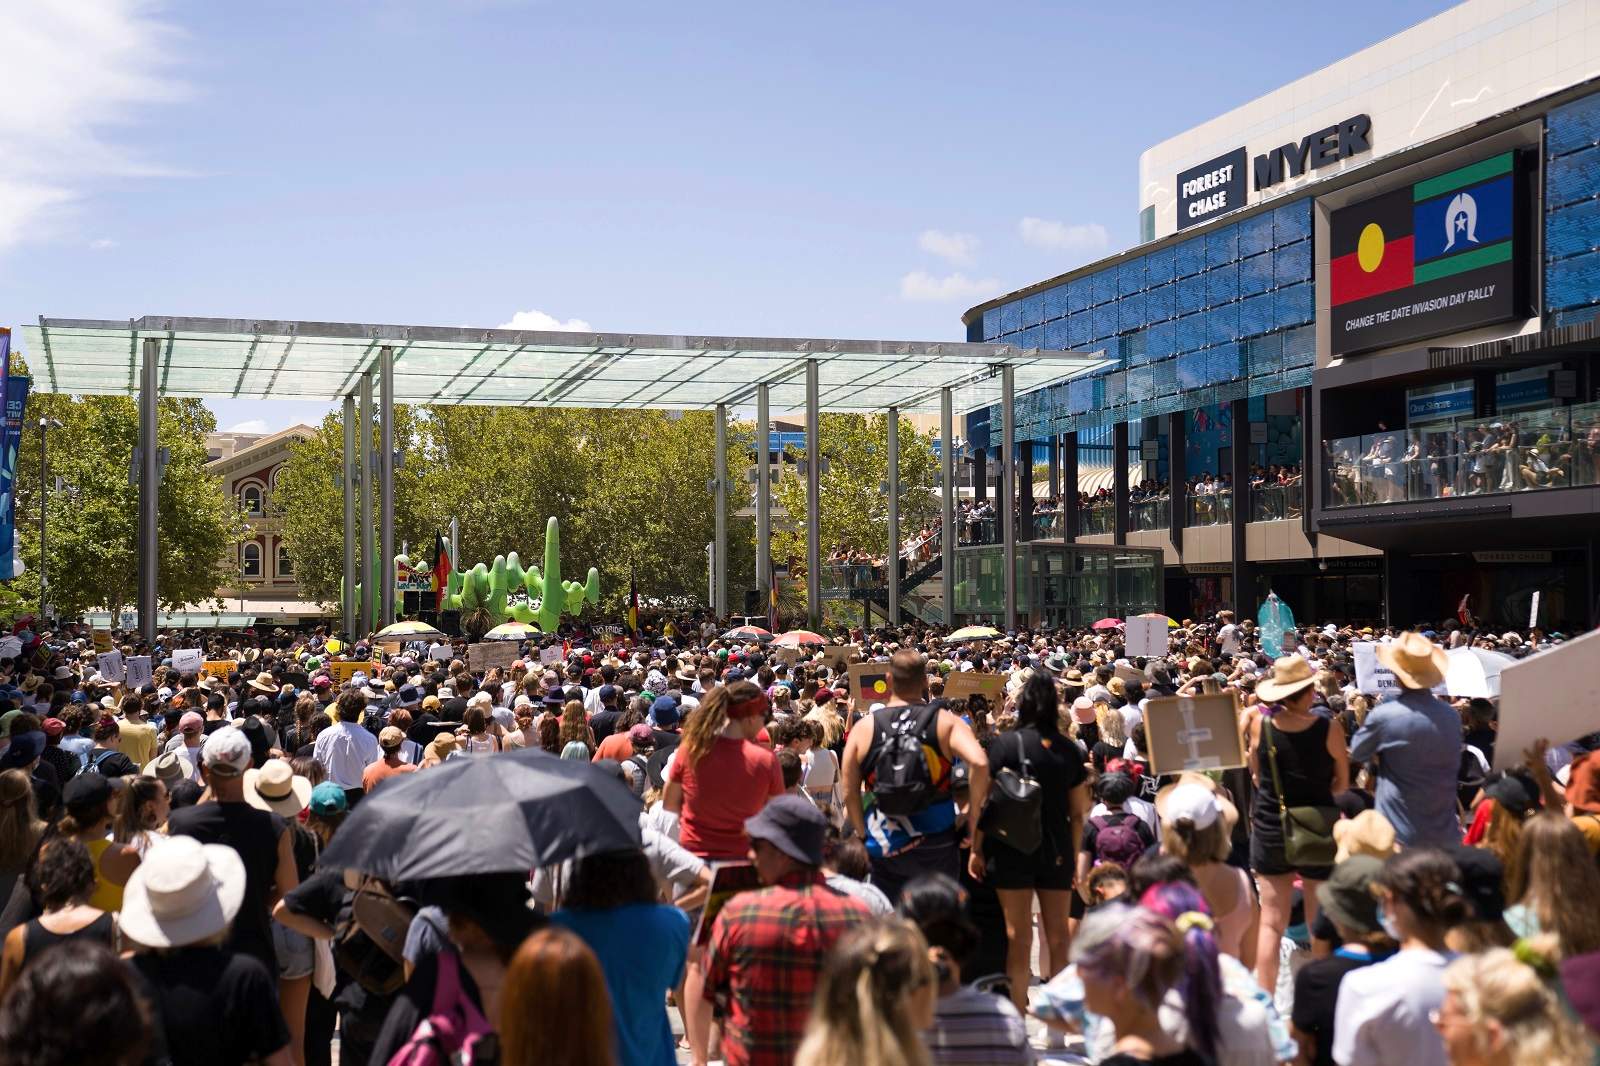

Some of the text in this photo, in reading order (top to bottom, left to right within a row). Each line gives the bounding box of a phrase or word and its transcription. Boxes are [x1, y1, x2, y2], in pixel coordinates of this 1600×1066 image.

[1254, 113, 1372, 192] MYER
[1183, 165, 1234, 198] FORREST
[1189, 191, 1227, 219] CHASE
[1345, 284, 1496, 332] CHANGE THE DATE INVASION DAY RALLY
[592, 625, 624, 636] NO PRIDE
